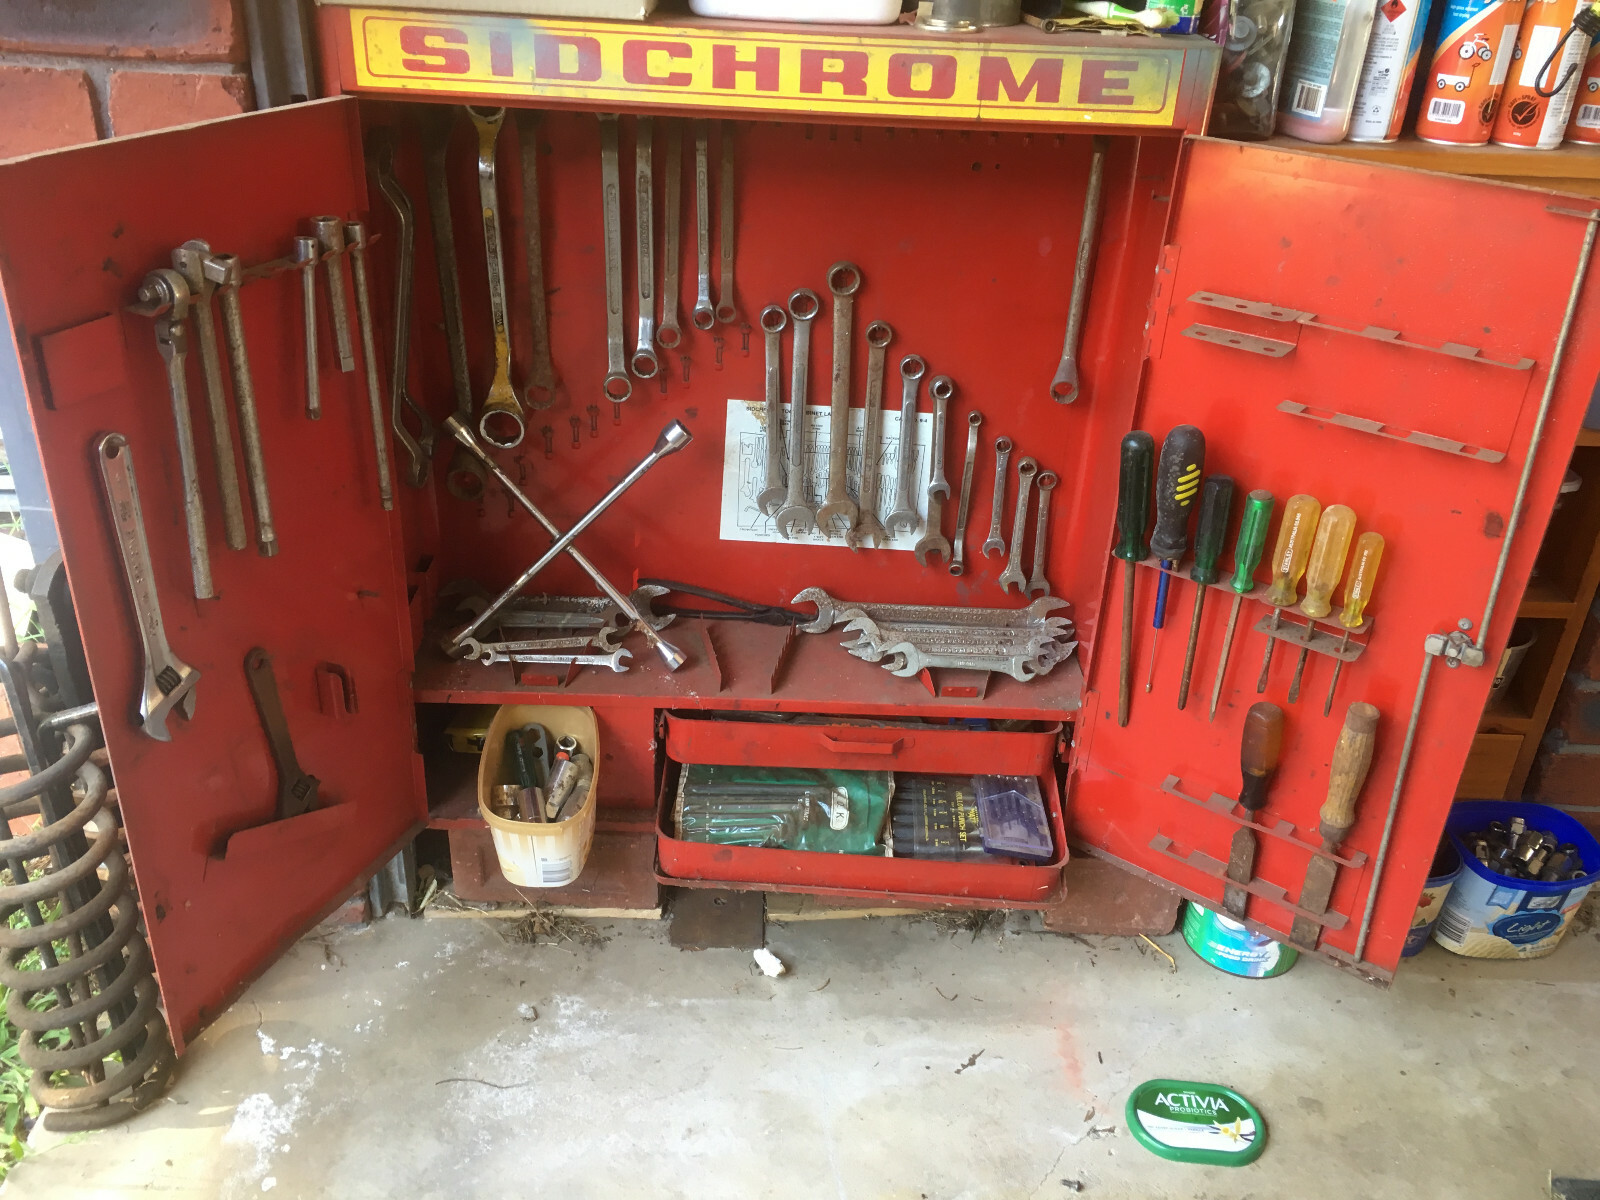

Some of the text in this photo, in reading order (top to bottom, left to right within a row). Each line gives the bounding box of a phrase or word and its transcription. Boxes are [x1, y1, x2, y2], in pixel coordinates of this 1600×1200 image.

[400, 25, 1139, 106] SIDCHROME
[955, 790, 967, 843] HOLLOW PUNCH SET
[1216, 943, 1267, 958] ENERGY
[1217, 951, 1241, 961] FOOD
[1155, 1092, 1230, 1112] ACTIVIA
[1169, 1106, 1217, 1116] PROBIOTICS
